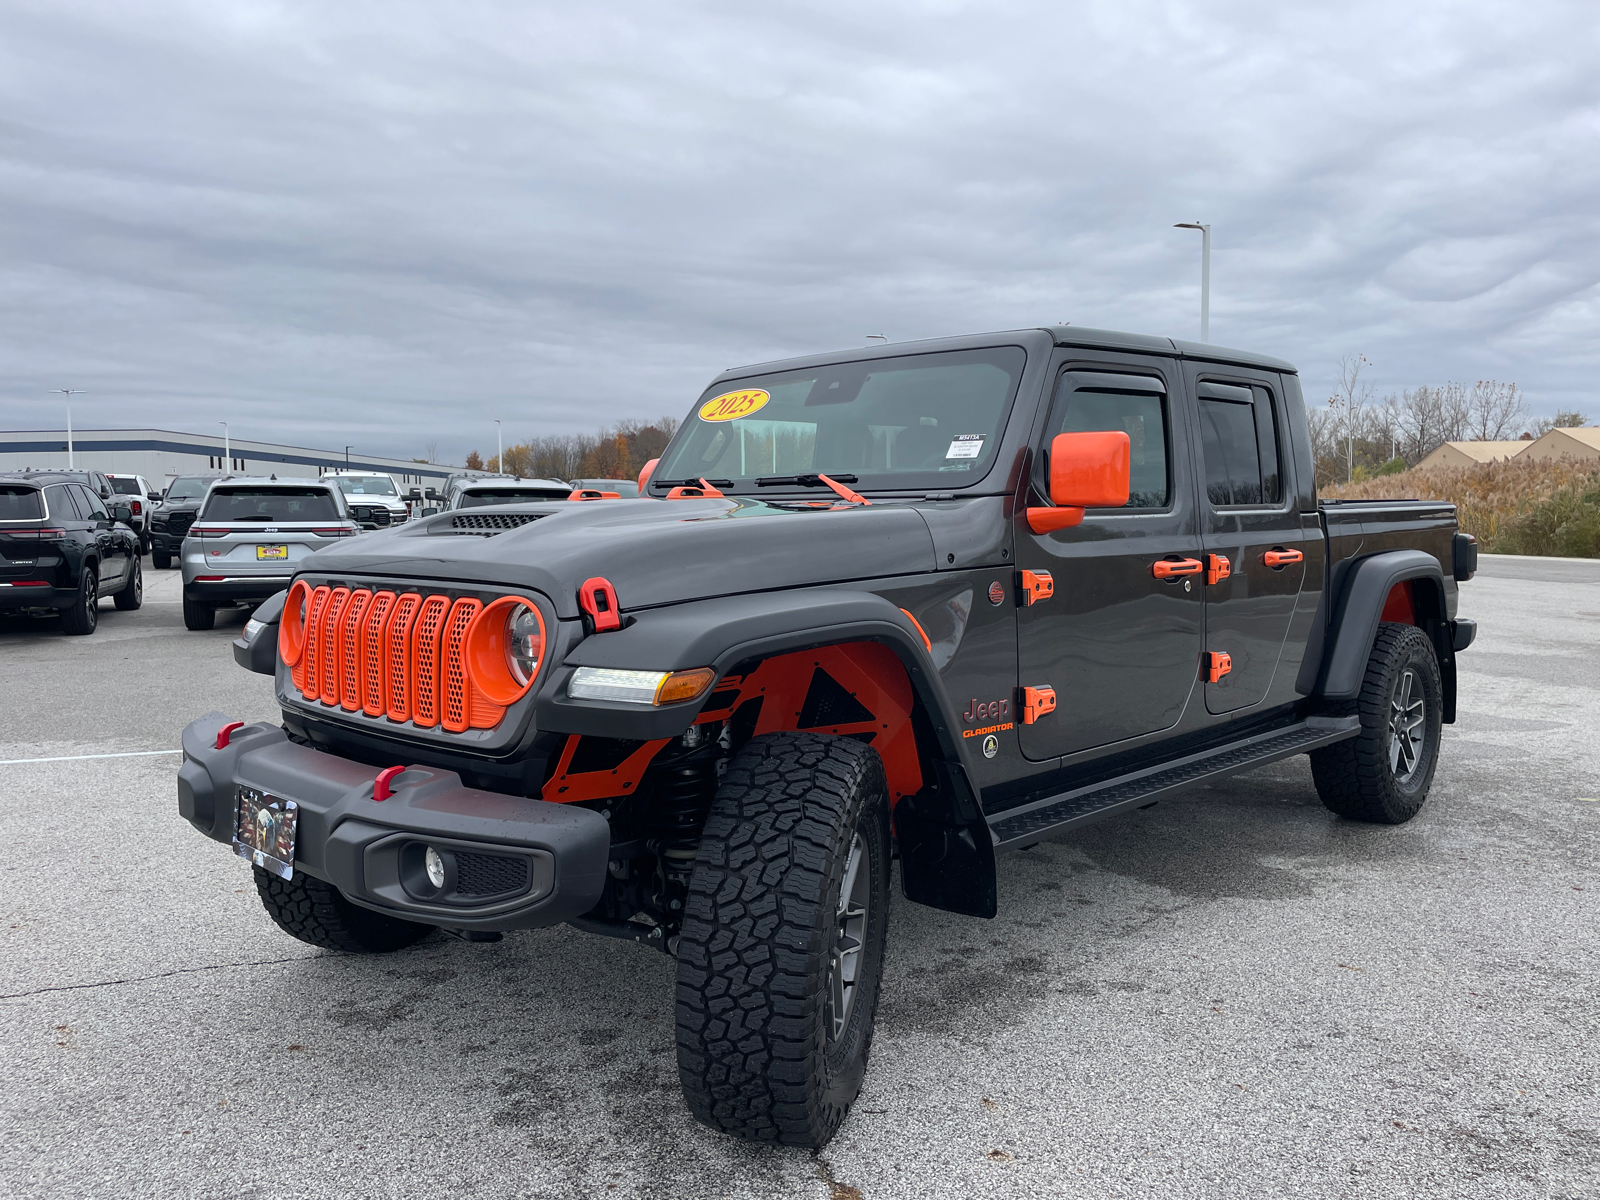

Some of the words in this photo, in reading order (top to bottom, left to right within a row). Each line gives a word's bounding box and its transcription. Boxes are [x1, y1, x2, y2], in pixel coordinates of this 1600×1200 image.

[706, 393, 762, 418] 2025
[963, 698, 1009, 724] Jeep
[963, 722, 1014, 739] GLADIATOR
